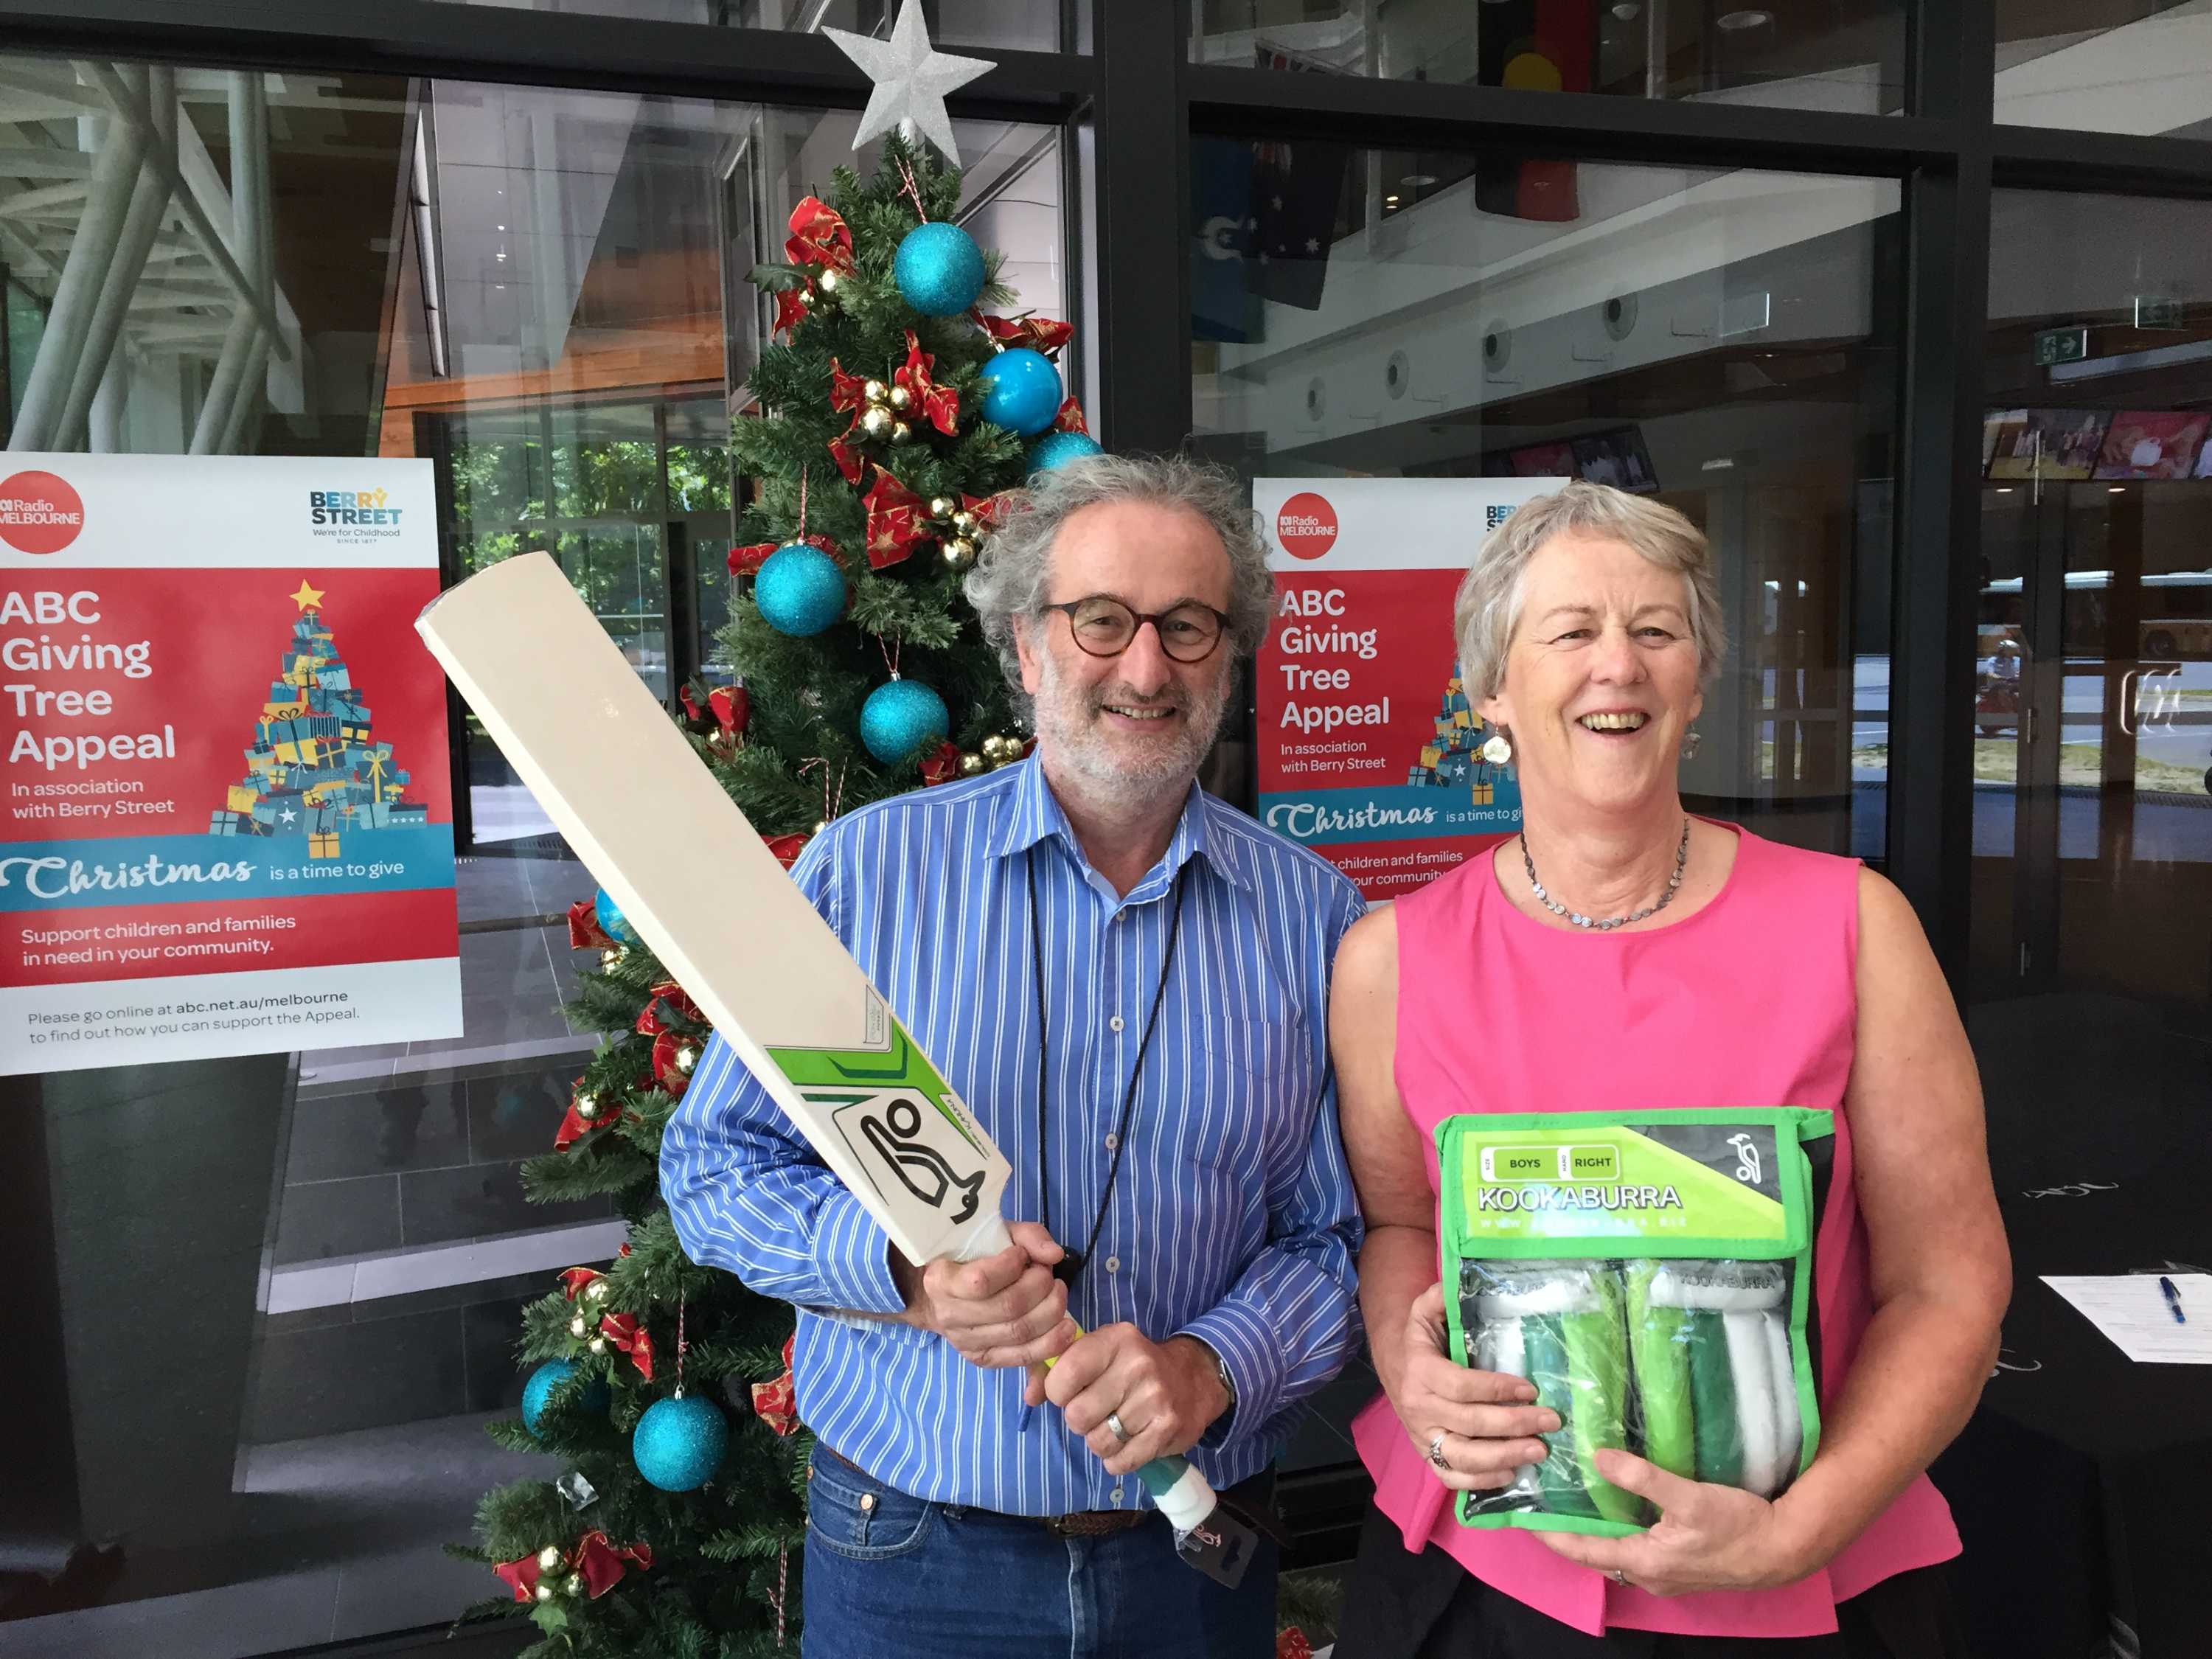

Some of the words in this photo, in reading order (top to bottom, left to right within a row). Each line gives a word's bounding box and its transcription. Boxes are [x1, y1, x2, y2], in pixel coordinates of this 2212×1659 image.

[14, 499, 54, 512] Radio
[310, 487, 388, 508] BERRY
[312, 508, 403, 525] STREET
[1293, 515, 1318, 526] Radio
[339, 528, 352, 537] for
[354, 528, 401, 538] Childhood
[1280, 526, 1336, 537] MELBOURNE
[0, 591, 101, 625] ABC
[1279, 589, 1346, 617] ABC
[1280, 625, 1378, 659] Giving
[2, 634, 153, 679] Giving
[1280, 664, 1351, 691] Tree
[4, 684, 113, 717] Tree
[1280, 697, 1390, 734] Appeal
[9, 724, 175, 771] Appeal
[1281, 745, 1293, 756] In
[1295, 741, 1367, 754] association
[1281, 761, 1308, 773] with
[1310, 759, 1346, 774] Berry
[1347, 757, 1386, 770] Street
[12, 783, 29, 797] In
[34, 779, 144, 796] association
[13, 803, 55, 819] with
[59, 802, 111, 818] Berry
[115, 800, 175, 815] Street
[1267, 801, 1438, 838] Christmas
[1446, 810, 1456, 823] is
[1458, 813, 1465, 822] a
[1467, 810, 1495, 821] time
[1498, 809, 1509, 820] to
[1512, 807, 1522, 822] gi
[1338, 855, 1388, 870] children
[1391, 853, 1414, 866] and
[1416, 850, 1464, 864] families
[0, 854, 257, 899] Christmas
[270, 866, 284, 880] is
[288, 869, 299, 880] a
[302, 864, 343, 878] time
[347, 863, 366, 876] to
[369, 860, 405, 879] give
[1352, 875, 1374, 886] our
[21, 927, 102, 946] Support
[105, 922, 182, 939] children
[186, 918, 220, 934] and
[224, 915, 296, 932] families
[24, 951, 40, 966] in
[45, 947, 93, 965] need
[97, 947, 114, 961] in
[117, 947, 161, 964] your
[164, 938, 274, 957] community.
[28, 1012, 80, 1025] Please
[83, 1010, 102, 1023] go
[106, 1006, 153, 1019] online
[157, 1005, 172, 1015] at
[176, 992, 348, 1014] abc.net.au/melbourne
[29, 1033, 46, 1044] to
[50, 1029, 80, 1043] find
[84, 1028, 111, 1040] out
[114, 1026, 147, 1037] how
[150, 1023, 178, 1037] you
[181, 1021, 209, 1032] can
[213, 1015, 274, 1030] support
[276, 1012, 302, 1025] the
[305, 1007, 361, 1024] Appeal.
[1510, 1159, 1541, 1169] BOYS
[1575, 1158, 1611, 1167] RIGHT
[1478, 1185, 1683, 1211] KOOKABURRA
